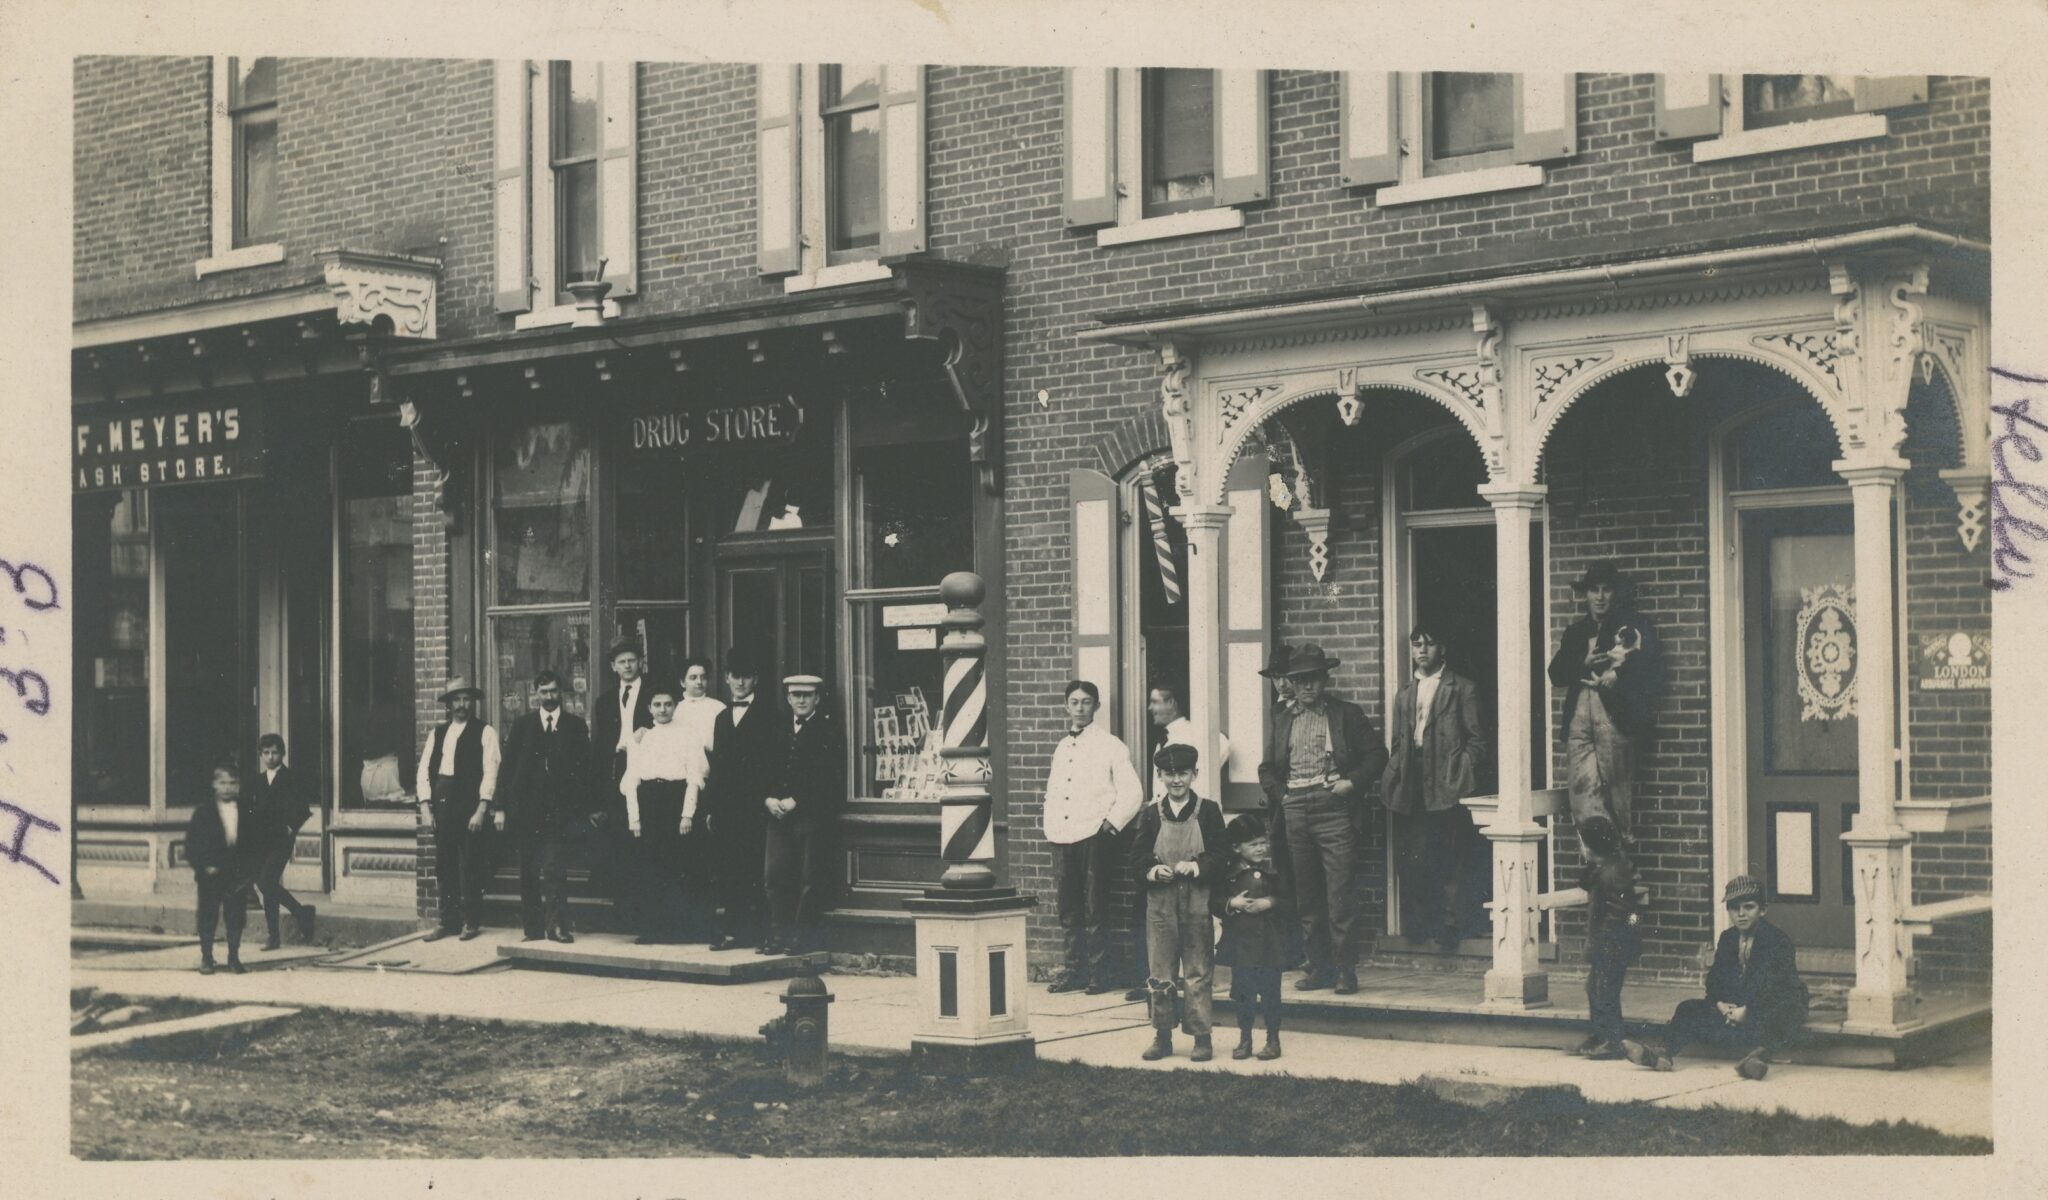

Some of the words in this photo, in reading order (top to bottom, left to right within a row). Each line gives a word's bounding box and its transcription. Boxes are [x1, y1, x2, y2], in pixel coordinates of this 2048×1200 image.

[633, 412, 691, 449] DRUG
[79, 464, 122, 488] ASH
[140, 455, 232, 483] STORE.
[1934, 665, 1987, 678] LONDON
